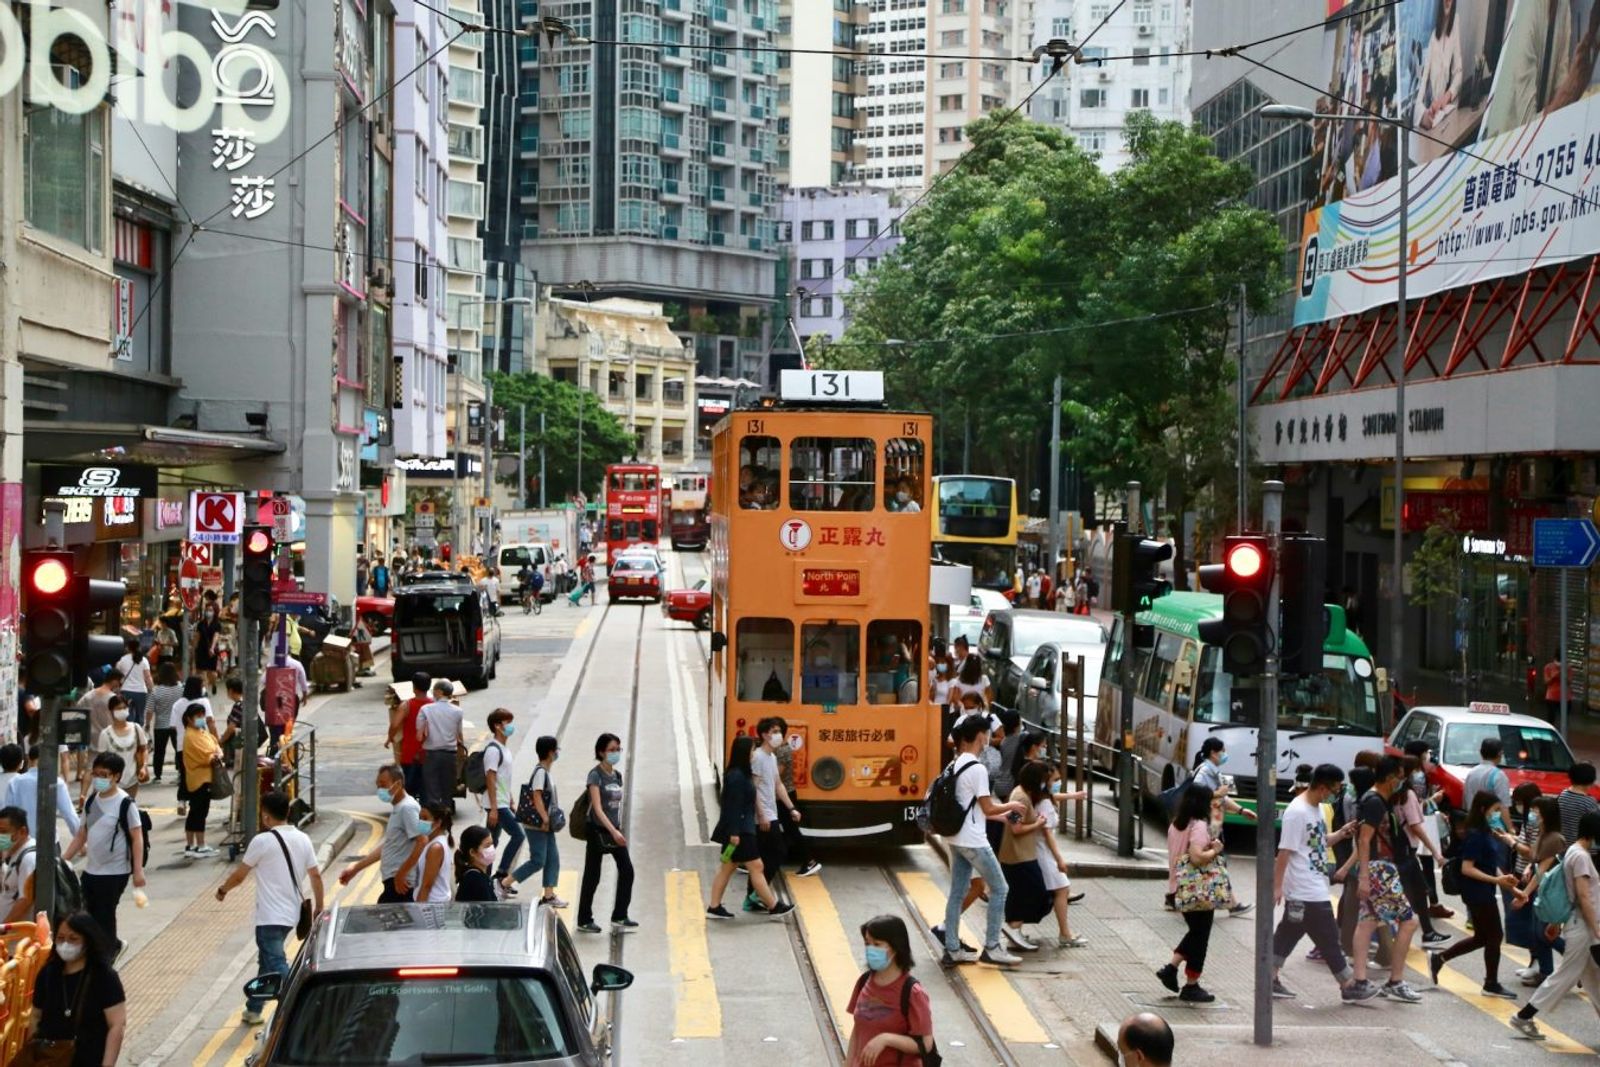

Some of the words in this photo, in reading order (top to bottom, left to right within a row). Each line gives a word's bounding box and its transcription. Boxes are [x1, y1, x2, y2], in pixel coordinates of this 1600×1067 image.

[1533, 140, 1577, 188] 2755
[211, 127, 276, 220] 莎莎
[811, 374, 850, 396] 131
[747, 420, 764, 433] 131
[1408, 407, 1444, 433] STADIUM
[902, 422, 918, 435] 131
[57, 486, 141, 496] SKECHERS
[818, 527, 886, 546] 正露丸
[807, 572, 834, 581] North
[836, 572, 857, 581] Poin
[818, 728, 896, 742] 家居旅行必備
[368, 987, 388, 996] Golf
[445, 985, 461, 993] The
